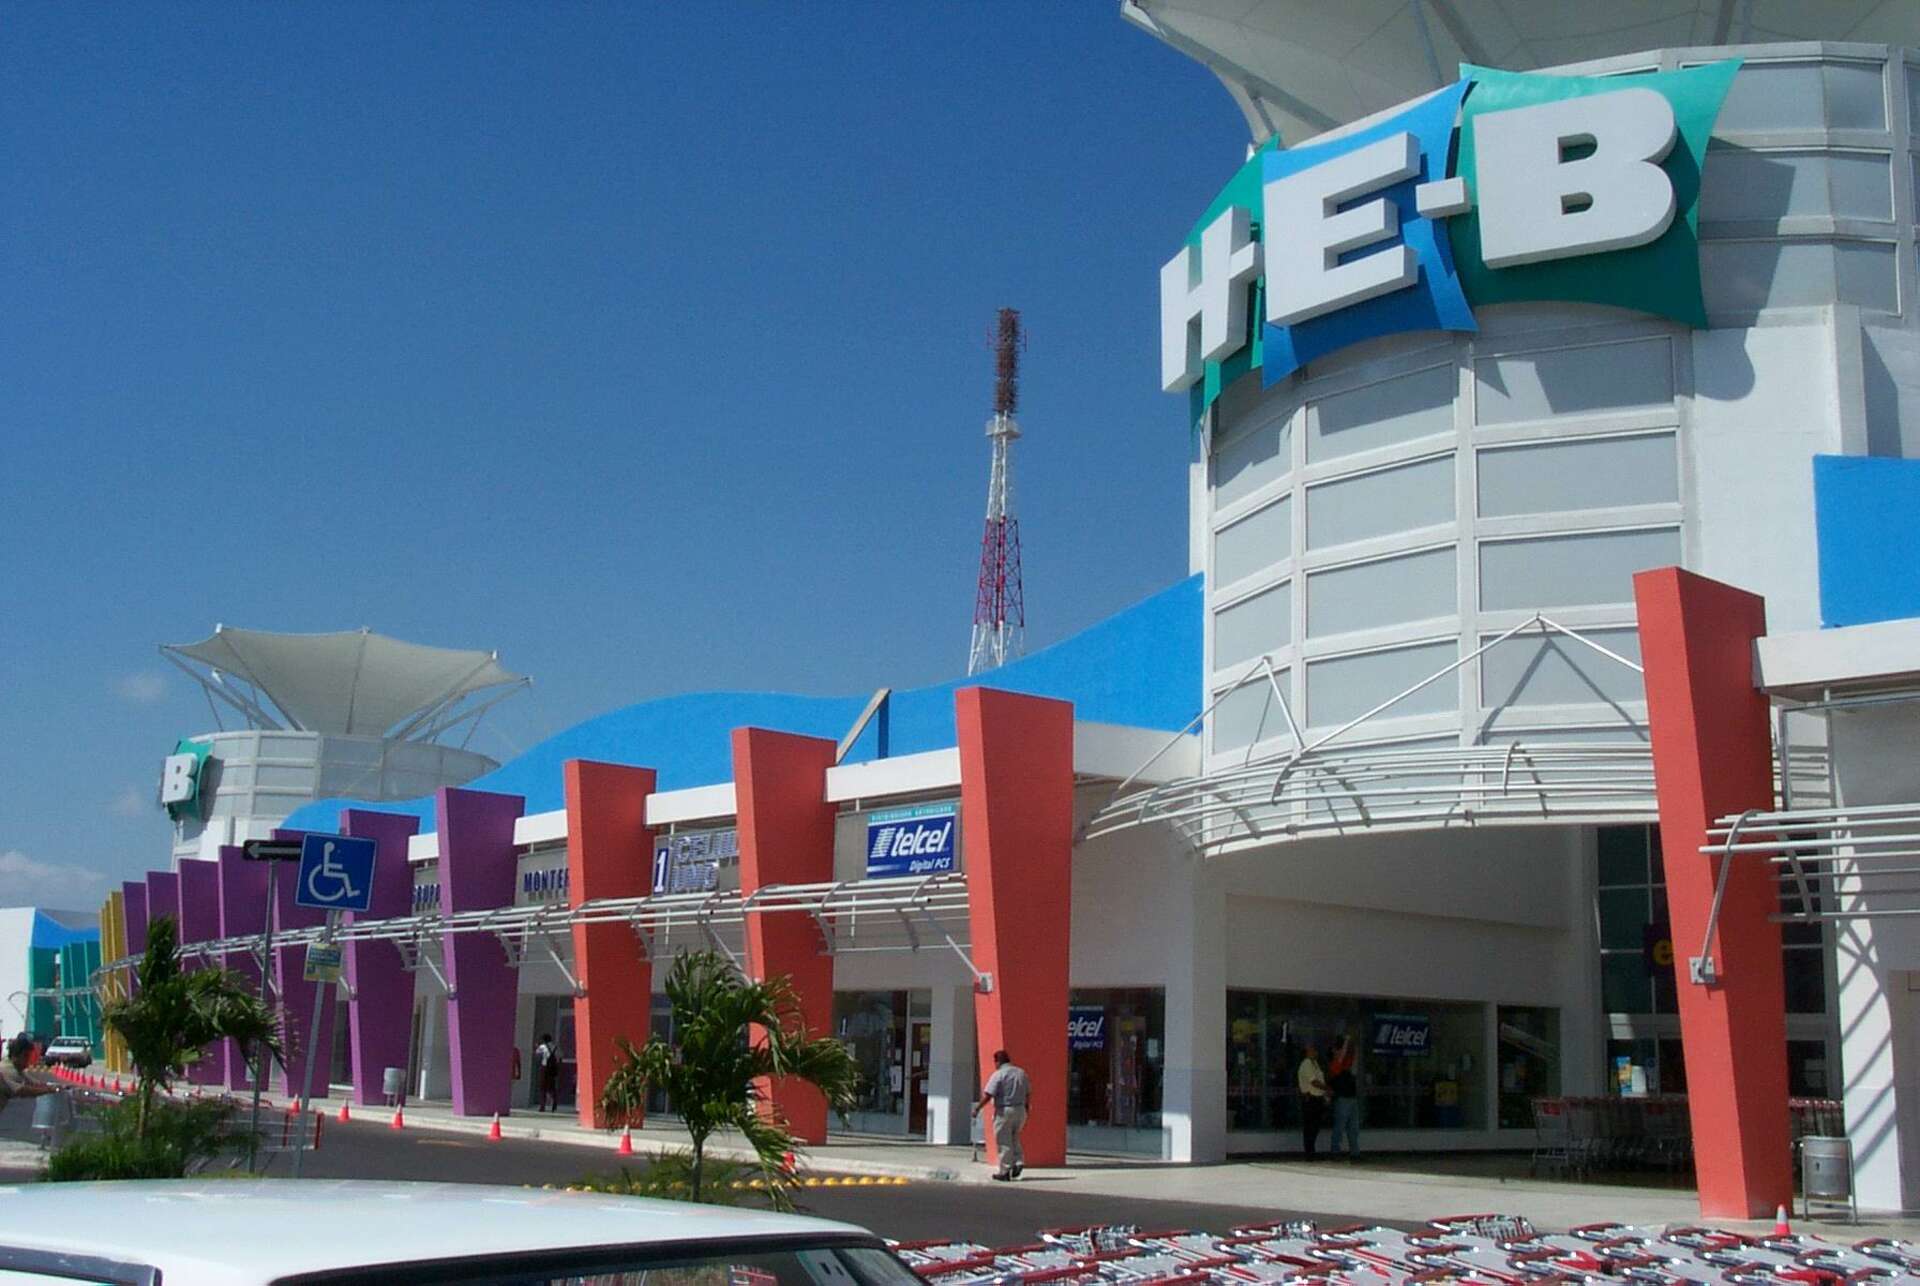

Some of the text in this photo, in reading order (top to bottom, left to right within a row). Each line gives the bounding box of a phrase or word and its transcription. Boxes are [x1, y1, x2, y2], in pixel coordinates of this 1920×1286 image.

[161, 751, 199, 803] B
[890, 821, 952, 857] telcel
[934, 857, 951, 870] PCS
[1067, 1016, 1105, 1037] elcel
[1389, 1025, 1430, 1047] telcel
